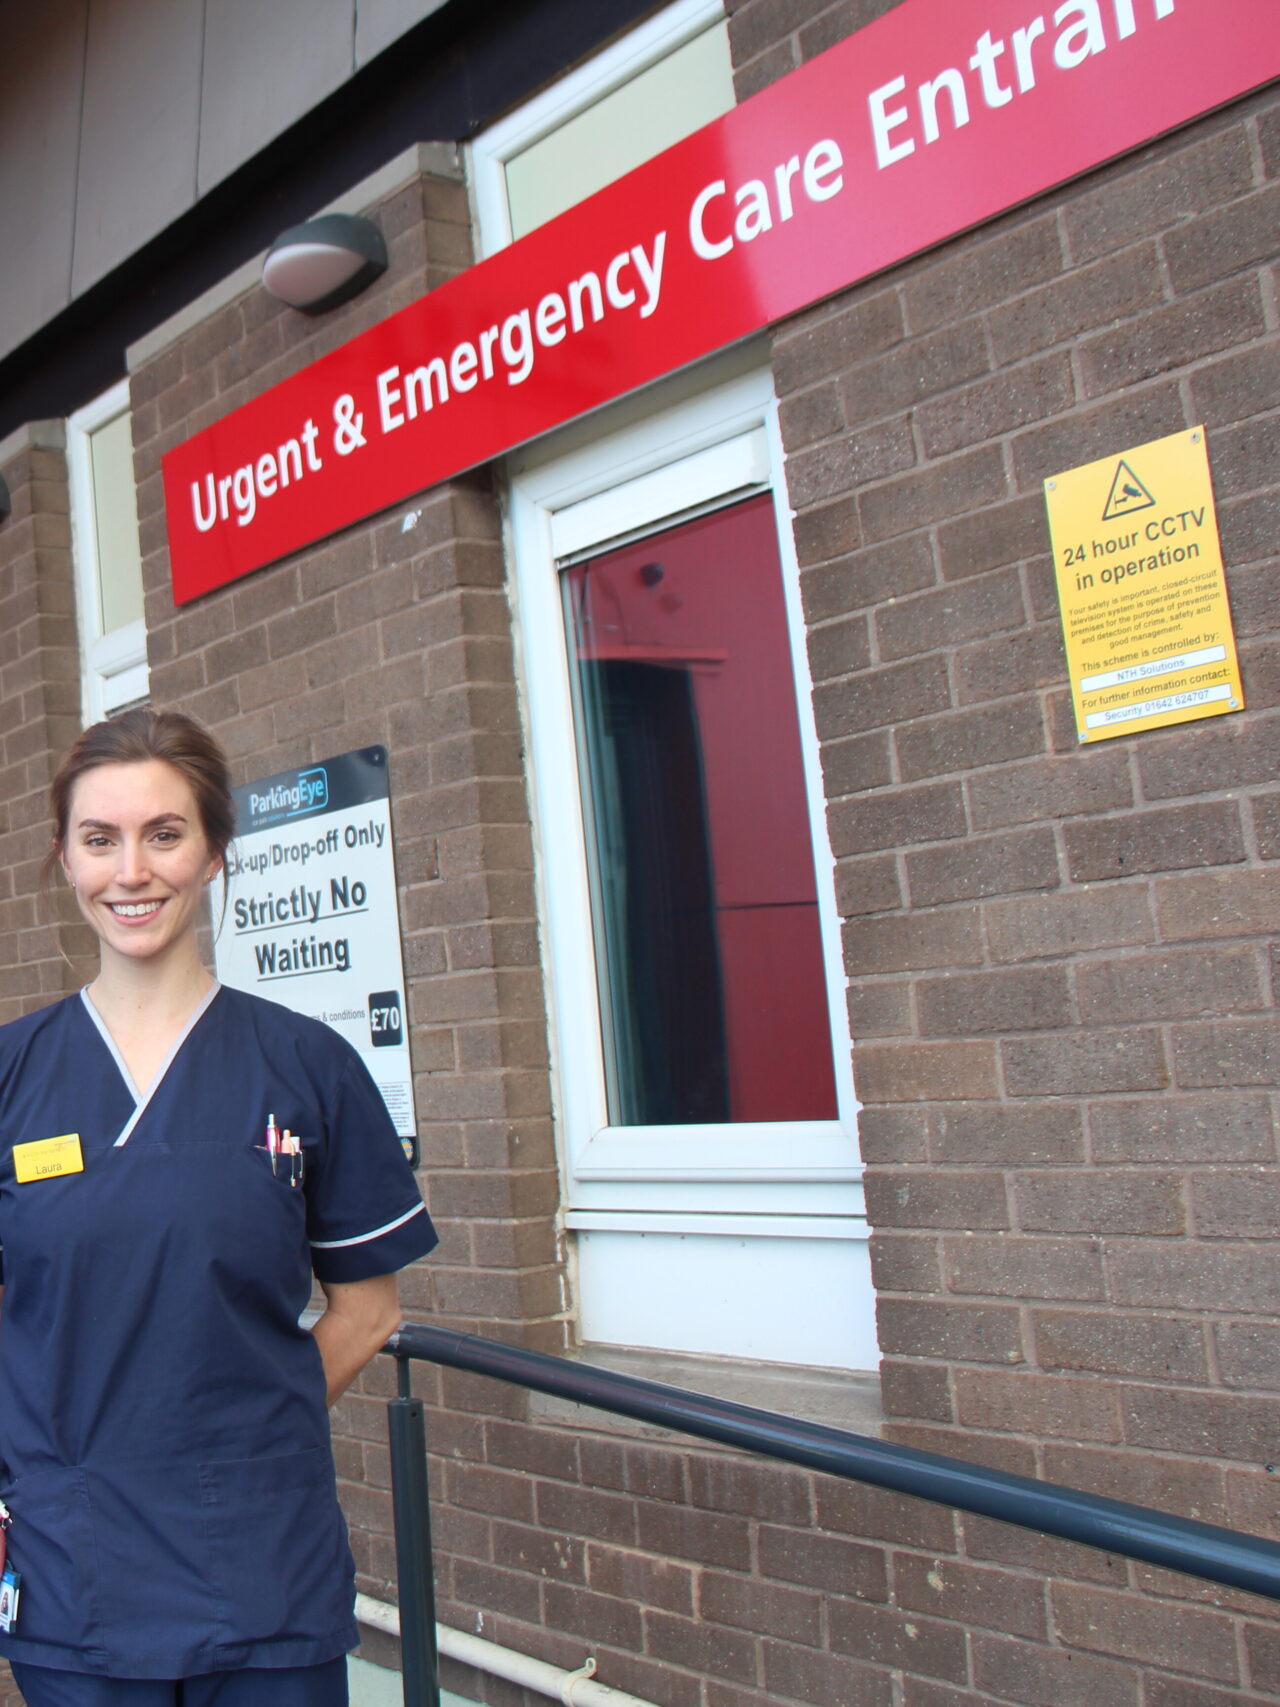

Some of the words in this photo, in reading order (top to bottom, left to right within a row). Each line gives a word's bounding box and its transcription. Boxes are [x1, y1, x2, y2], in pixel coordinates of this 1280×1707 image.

[190, 418, 321, 532] Urgent
[332, 394, 367, 457] &
[376, 231, 668, 434] Emergency
[687, 138, 844, 260] Care
[1063, 544, 1087, 567] 24
[1091, 531, 1139, 558] hour
[1145, 506, 1205, 541] CCTV
[1075, 572, 1094, 591] in
[1100, 543, 1200, 584] operation
[1069, 606, 1086, 616] Your
[1087, 600, 1110, 612] safety
[1111, 597, 1119, 605] is
[1120, 586, 1160, 602] important,
[1161, 570, 1217, 591] closed-circuit
[1070, 611, 1106, 626] television
[1108, 604, 1135, 617] system
[1136, 600, 1144, 608] is
[1146, 591, 1181, 606] operated
[1182, 588, 1193, 596] on
[1194, 581, 1218, 593] these
[1071, 623, 1104, 638] premises
[1106, 618, 1117, 627] for
[1118, 615, 1131, 624] the
[1133, 607, 1165, 621] purpose
[1167, 603, 1175, 612] of
[1177, 592, 1220, 610] prevention
[1082, 635, 1095, 645] and
[1097, 626, 1132, 641] detection
[1133, 622, 1142, 631] of
[1170, 610, 1194, 622] safety
[1196, 604, 1212, 615] and
[1082, 661, 1101, 672] This
[1103, 652, 1139, 666] scheme
[1141, 649, 1150, 657] is
[1152, 636, 1201, 655] controlled
[1203, 632, 1220, 643] by:
[1110, 637, 1129, 649] good
[1131, 624, 1184, 642] management.
[1082, 698, 1097, 709] For
[1099, 690, 1130, 705] further
[1132, 677, 1187, 696] information
[1190, 668, 1230, 684] contact:
[1117, 668, 1137, 681] NTH
[1139, 658, 1185, 676] Solutions
[1105, 705, 1143, 721] Security
[1145, 698, 1173, 712] 01642
[1175, 689, 1209, 705] 624707
[250, 778, 324, 815] ParkingEye
[227, 828, 339, 876] ck-up/Drop-off
[344, 820, 385, 848] Only
[234, 885, 321, 929] Strictly
[330, 875, 367, 907] No
[255, 935, 348, 975] Waiting
[329, 1009, 365, 1021] conditions
[371, 1006, 400, 1032] £70
[36, 1163, 62, 1175] Laura
